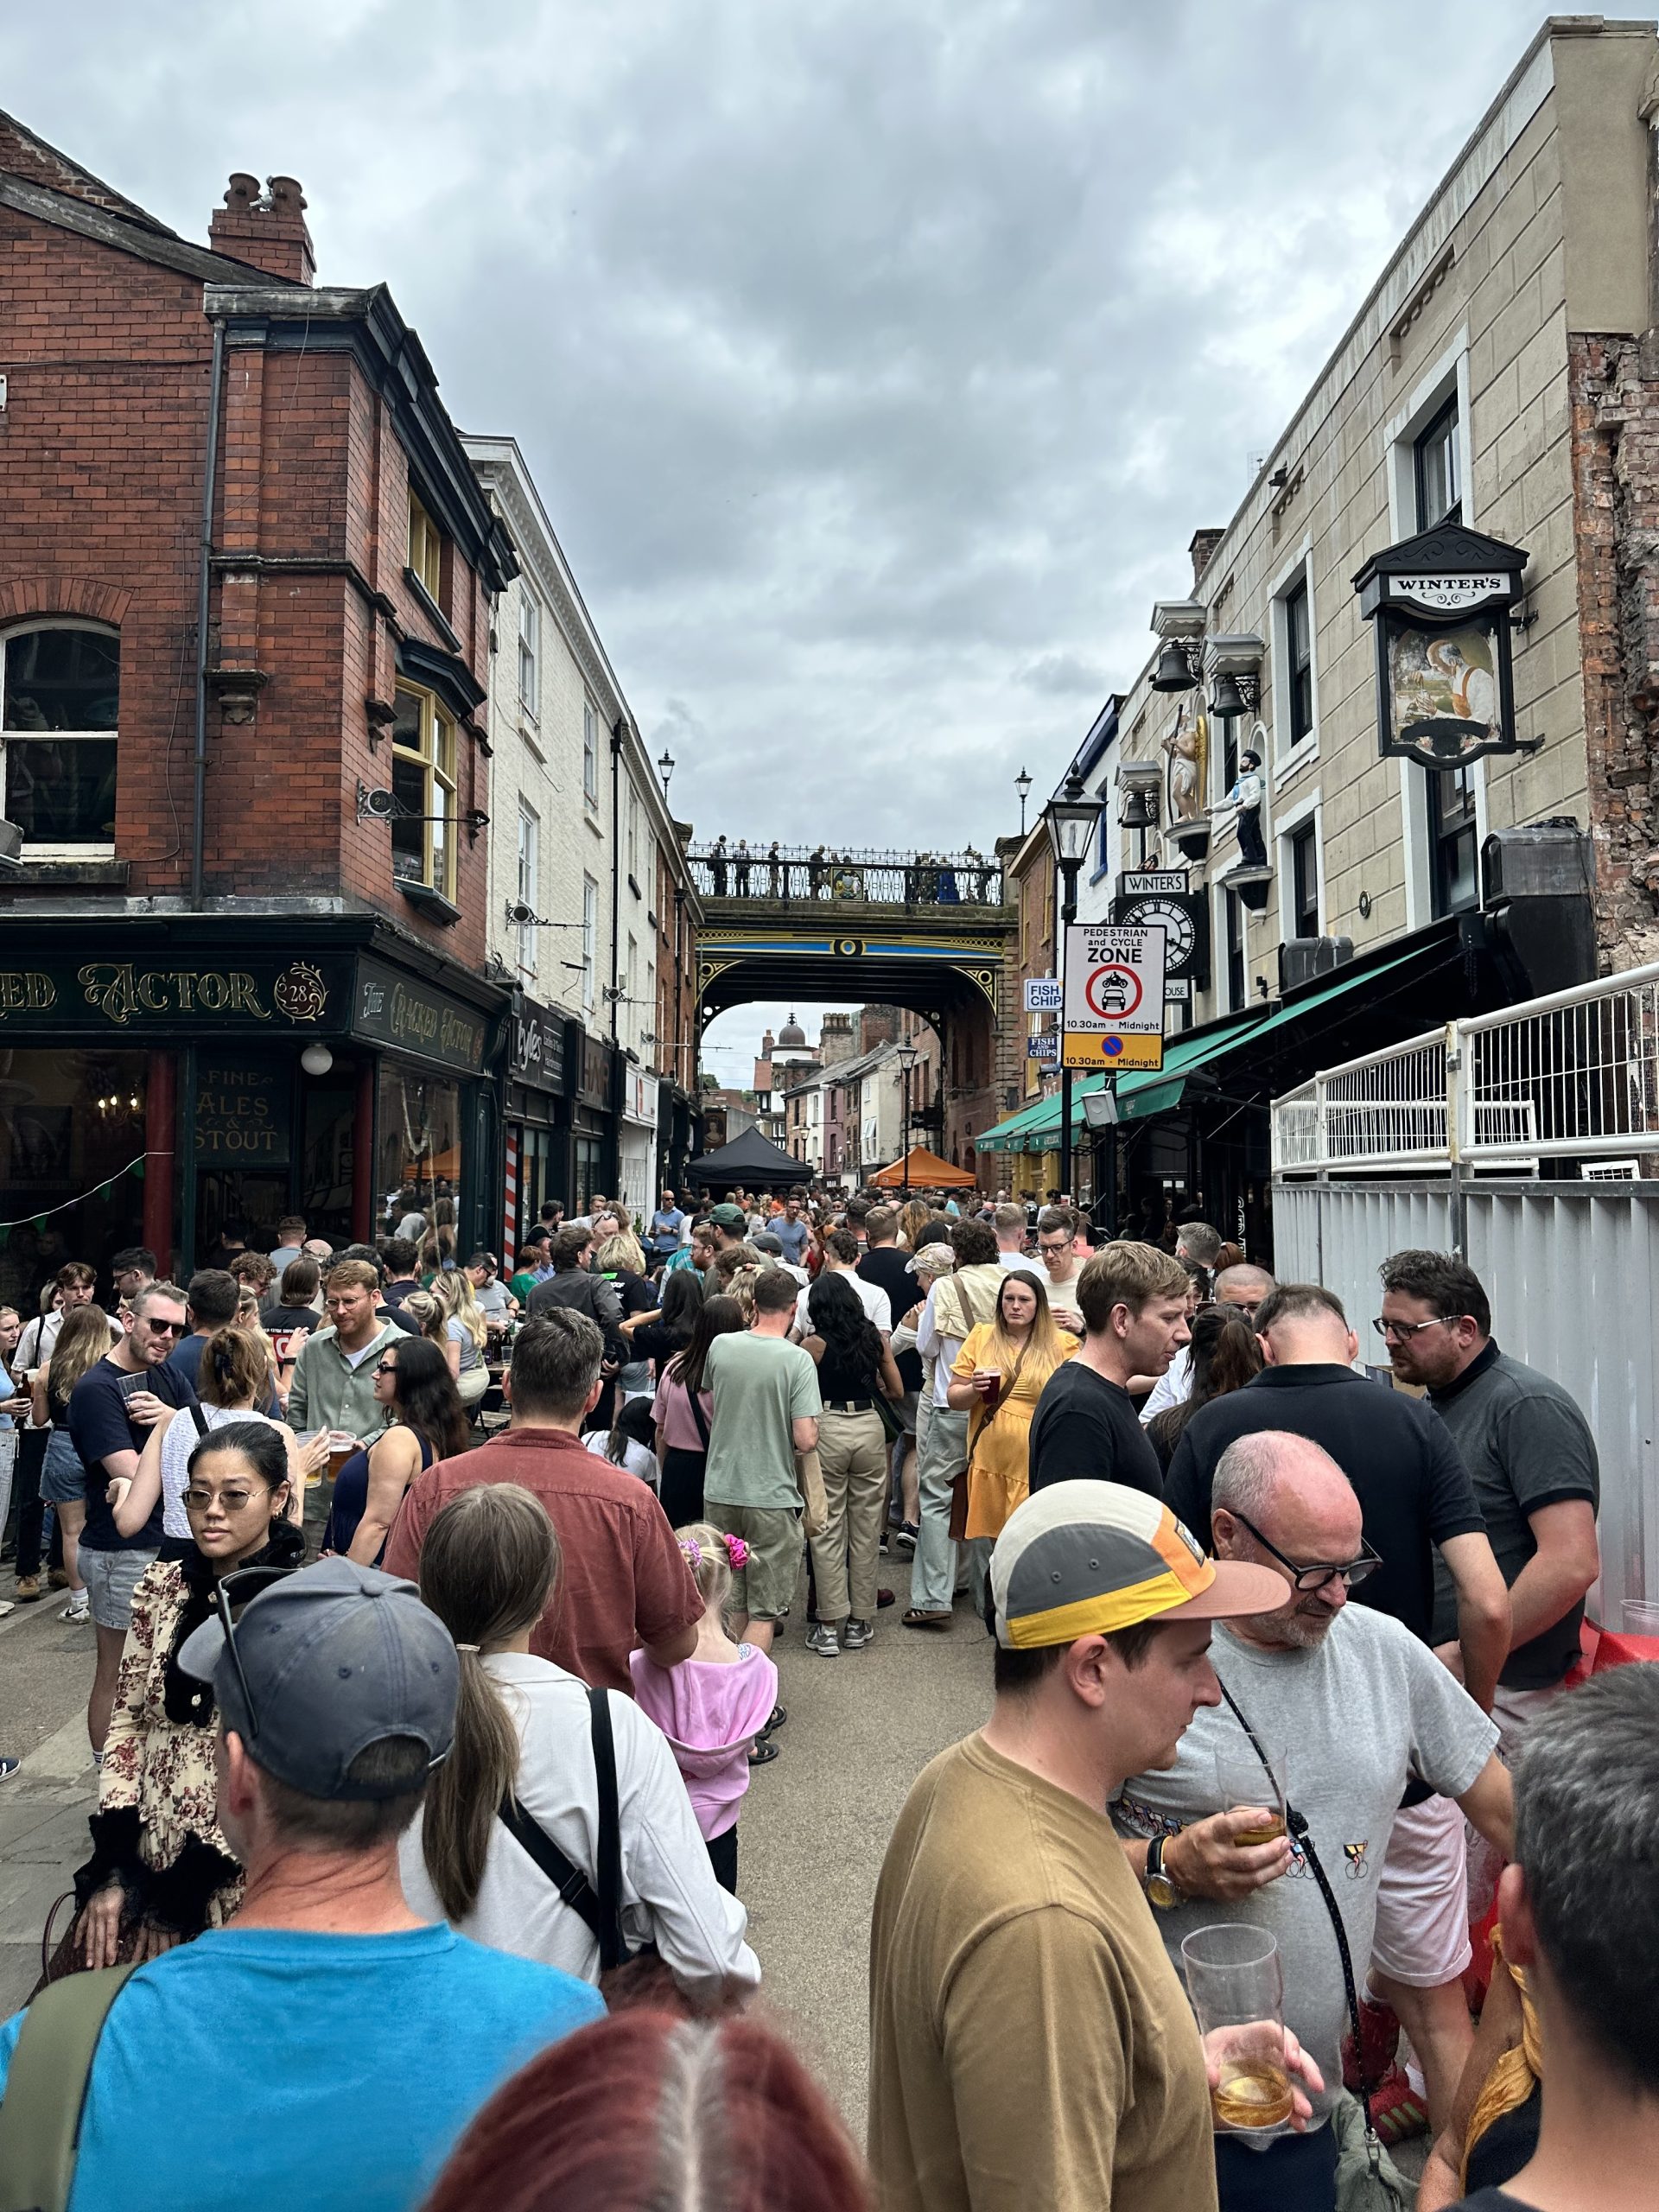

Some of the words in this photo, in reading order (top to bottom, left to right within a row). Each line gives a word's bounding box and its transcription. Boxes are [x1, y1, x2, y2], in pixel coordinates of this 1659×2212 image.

[1397, 577, 1501, 589] WINTER'S
[1128, 875, 1182, 891] WINTER'S
[1084, 928, 1148, 938] PEDESTRIAN
[1110, 938, 1143, 947] CYCLE
[1087, 948, 1142, 963] ZONE
[0, 973, 58, 1010] ED
[78, 963, 273, 1025] ACTOR
[289, 985, 308, 1003] 28
[1031, 985, 1059, 995] FISH
[1165, 987, 1185, 996] OUSE
[1031, 995, 1062, 1006] CHIP
[1066, 1020, 1106, 1029] 10.30am
[1118, 1021, 1160, 1031] Midnight
[518, 1020, 543, 1071] tyles
[1065, 1057, 1105, 1065] 10.30am
[1117, 1058, 1159, 1068] Midnight
[208, 1070, 259, 1086] FINE
[195, 1092, 269, 1116] ALES
[195, 1127, 278, 1151] STOUT
